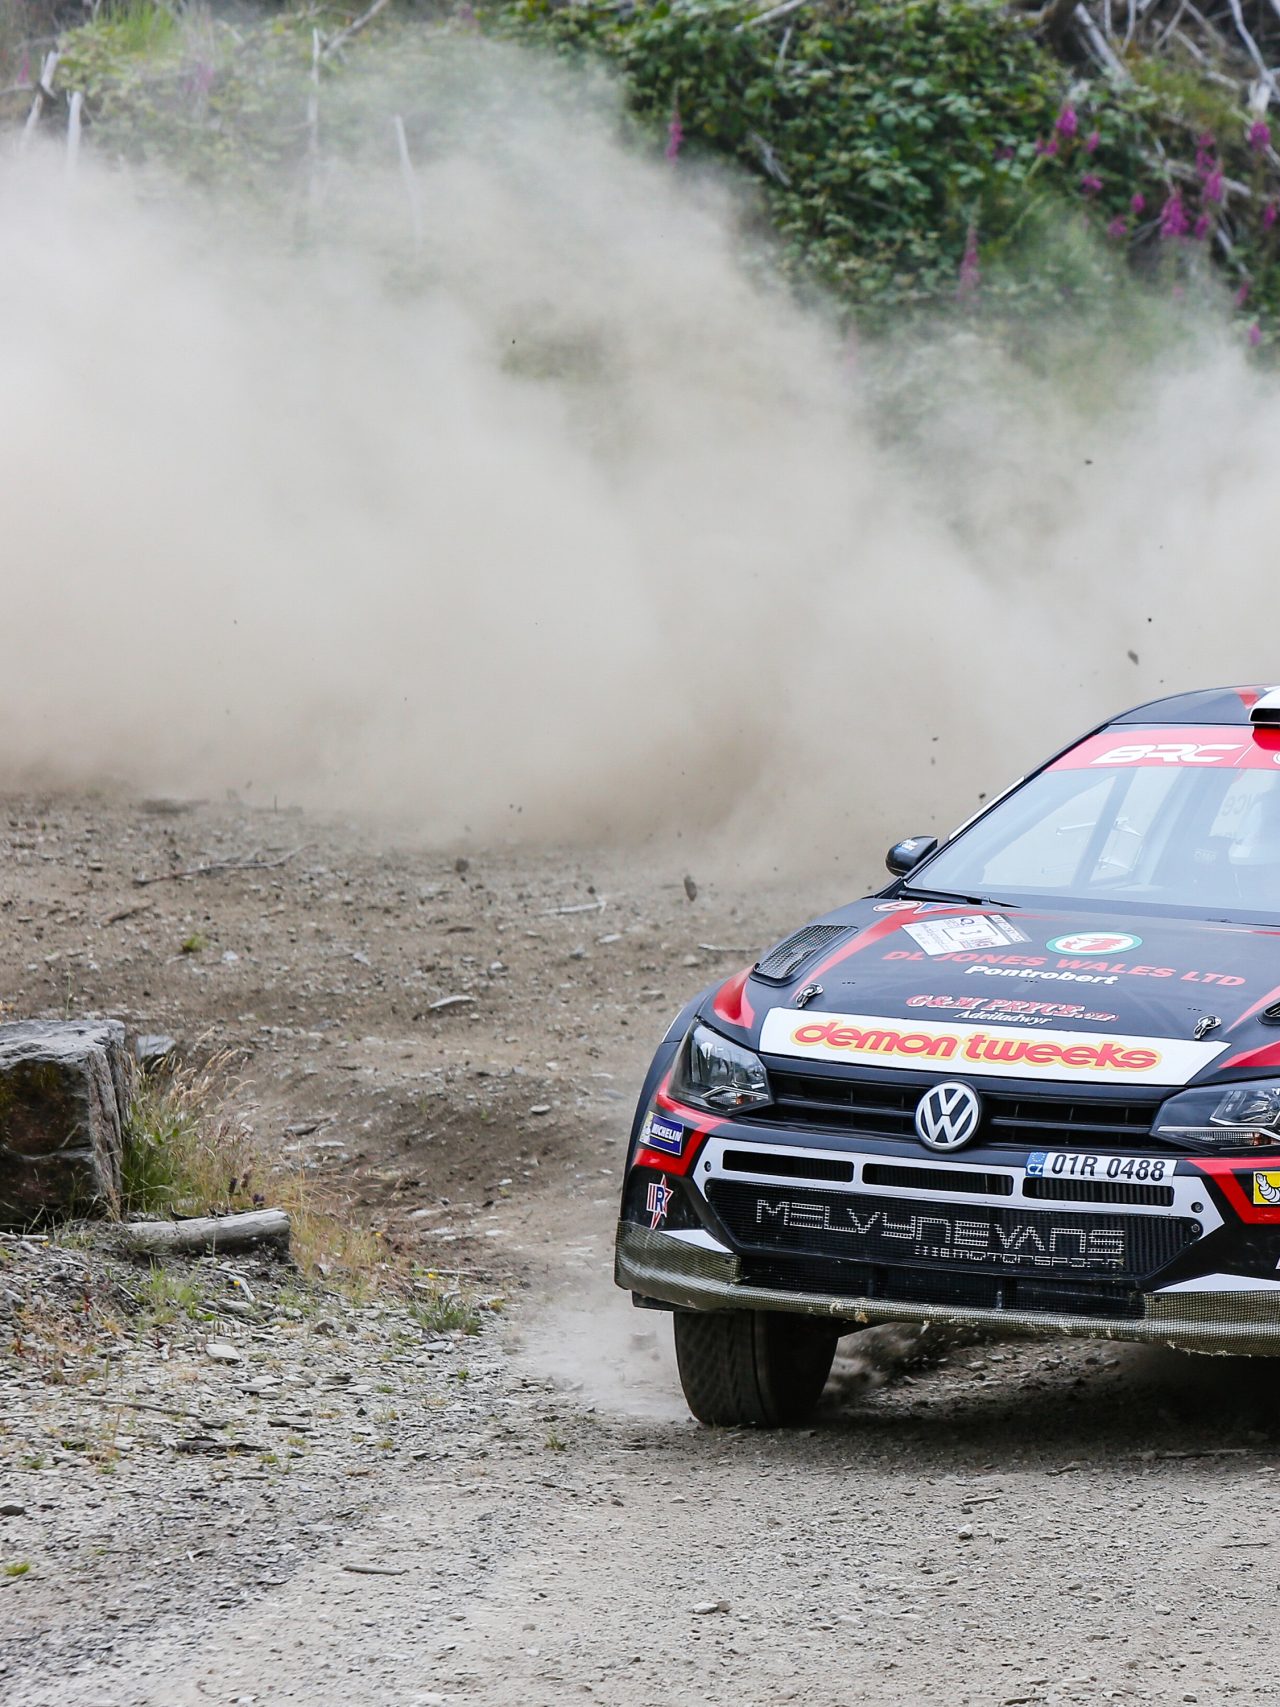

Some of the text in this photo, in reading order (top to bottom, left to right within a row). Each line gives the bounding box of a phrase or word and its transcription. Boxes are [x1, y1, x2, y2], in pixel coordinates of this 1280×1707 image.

[1090, 743, 1244, 765] BRC
[882, 951, 1247, 987] DL JONES WALES LTD
[964, 965, 1120, 985] Pontrobert
[953, 1009, 1054, 1026] Adeiladwyr
[795, 1021, 1158, 1069] demon tweeks
[651, 1122, 682, 1142] MICHELIN
[1027, 1164, 1043, 1176] CZ
[1051, 1154, 1166, 1182] 01R 0488
